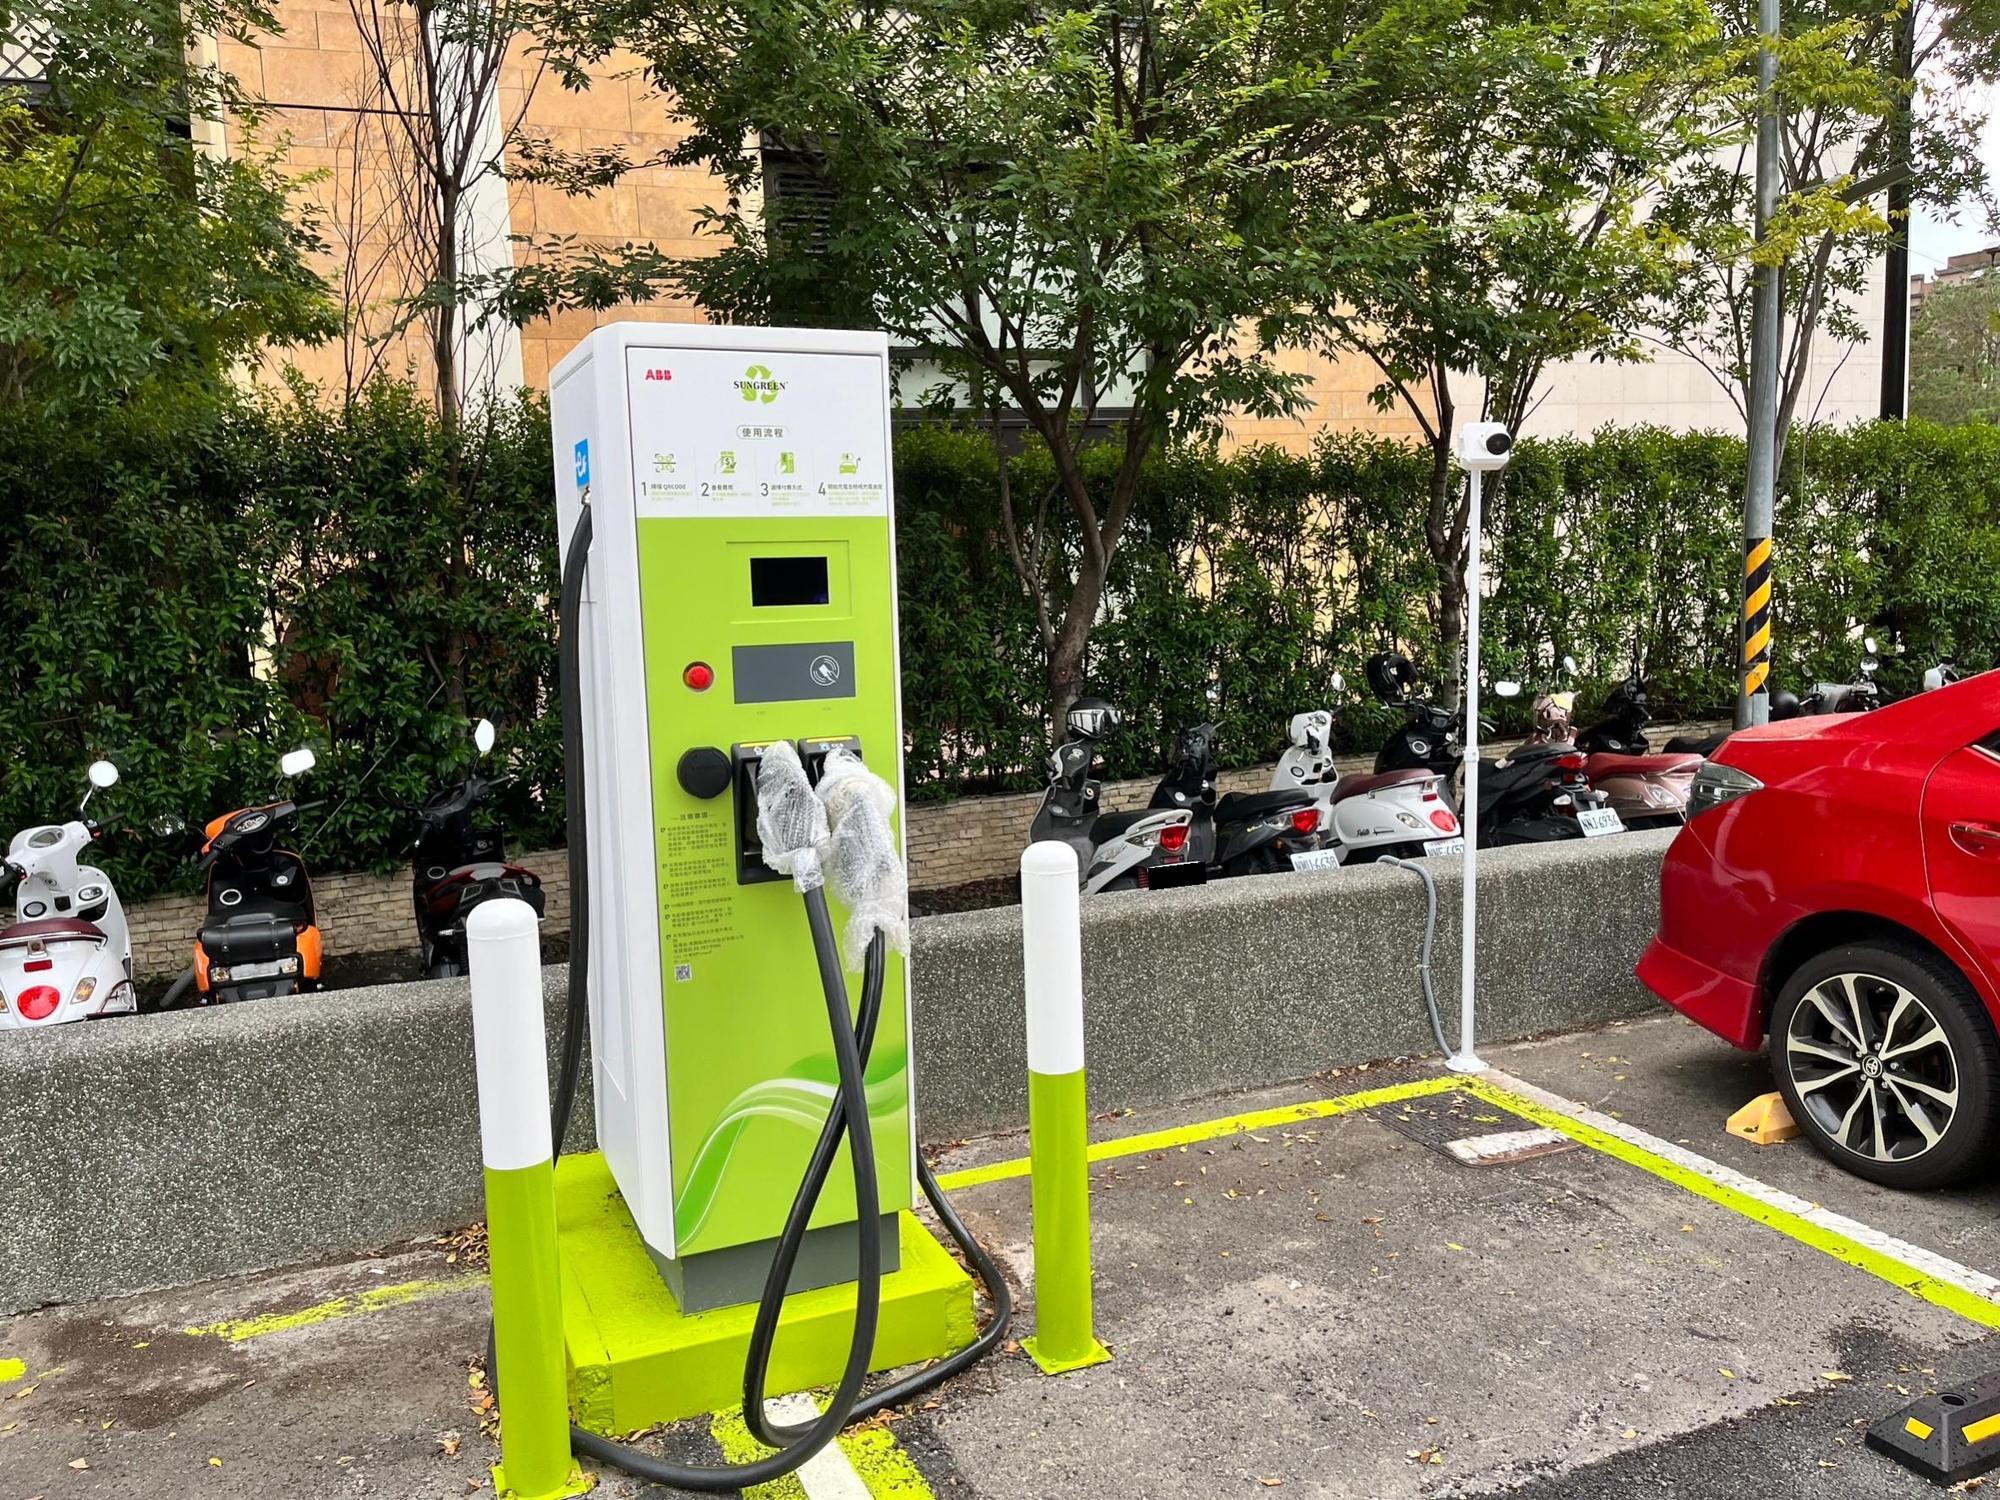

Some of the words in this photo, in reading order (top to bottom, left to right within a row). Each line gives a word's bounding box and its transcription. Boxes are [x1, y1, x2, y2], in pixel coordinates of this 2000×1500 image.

[645, 369, 672, 380] ABB
[733, 380, 786, 390] SUNGREEN
[742, 427, 784, 438] 使用流程
[641, 481, 647, 496] 1
[701, 482, 709, 496] 2
[760, 482, 769, 496] 3
[818, 482, 826, 496] 4
